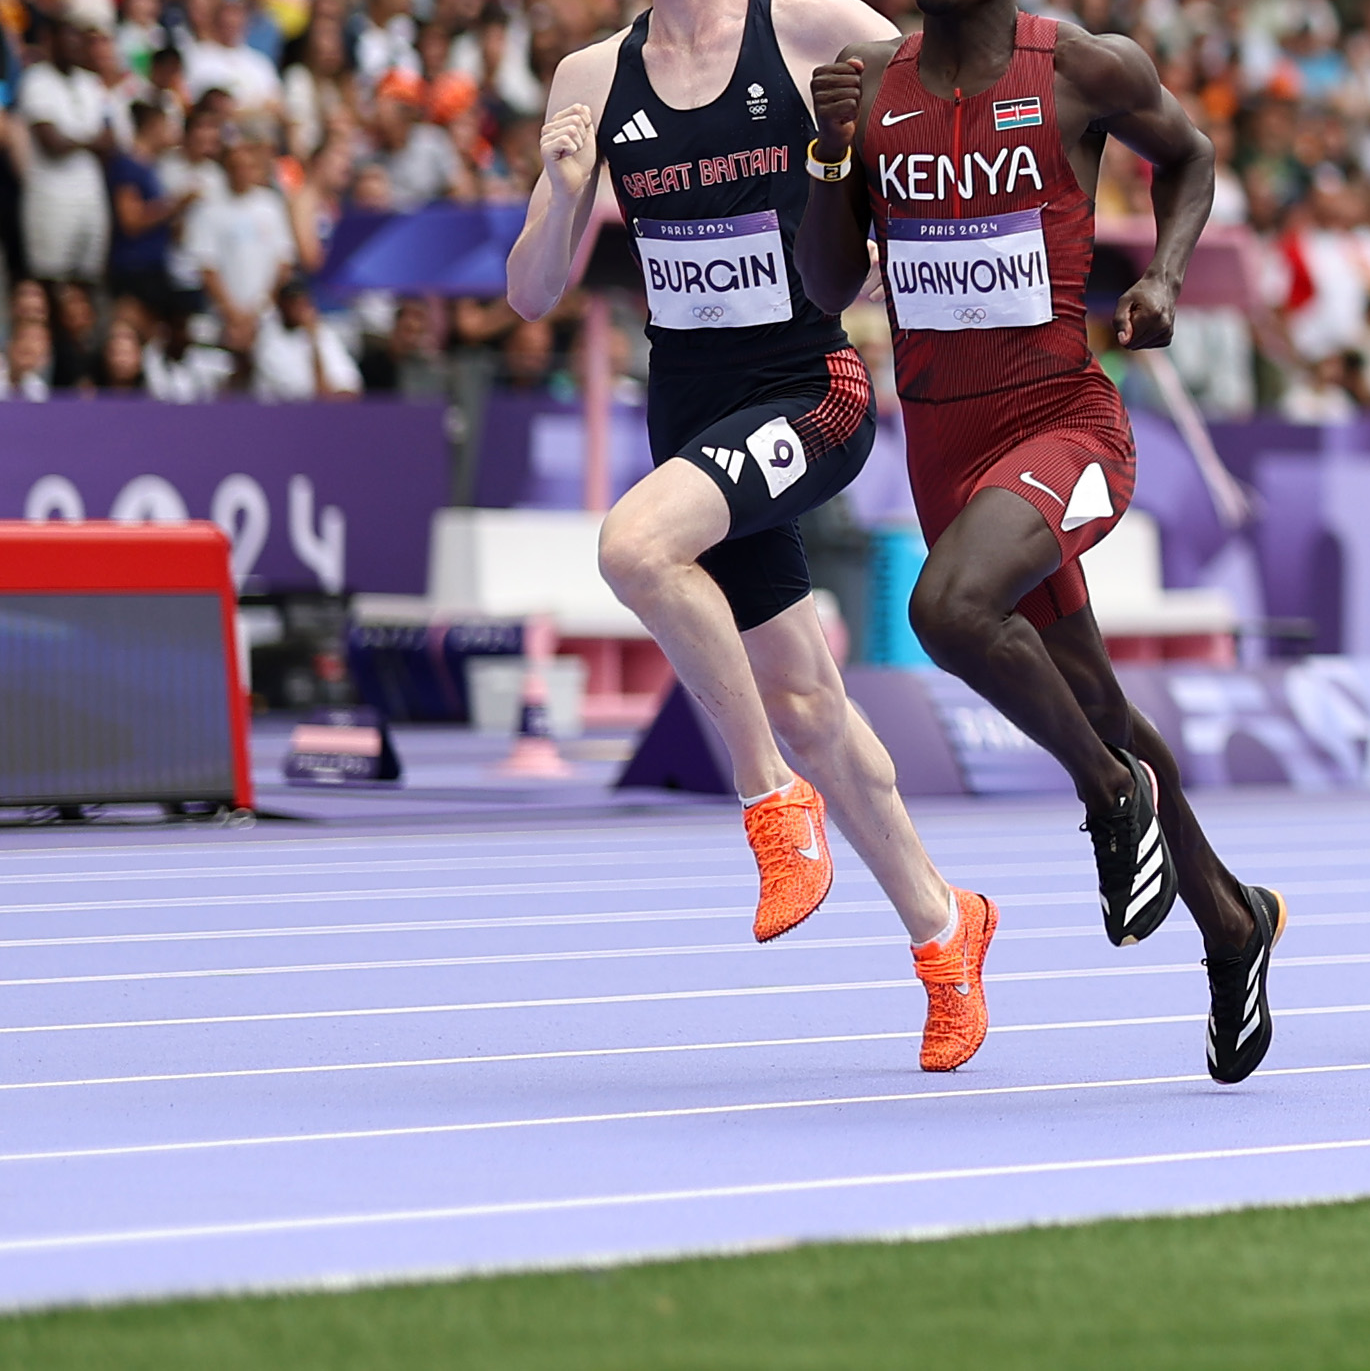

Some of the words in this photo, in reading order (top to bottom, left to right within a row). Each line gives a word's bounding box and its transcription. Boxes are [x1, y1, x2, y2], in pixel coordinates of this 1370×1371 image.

[621, 162, 692, 199] GREAT
[699, 146, 789, 186] BRITAIN
[879, 145, 1043, 200] KENYA
[661, 225, 693, 236] PARIS
[698, 223, 734, 235] 2024
[920, 224, 955, 236] PARIS
[959, 223, 998, 235] 2024
[650, 252, 778, 294] BURGIN
[892, 251, 1044, 295] WANYONYI
[768, 439, 794, 468] 9
